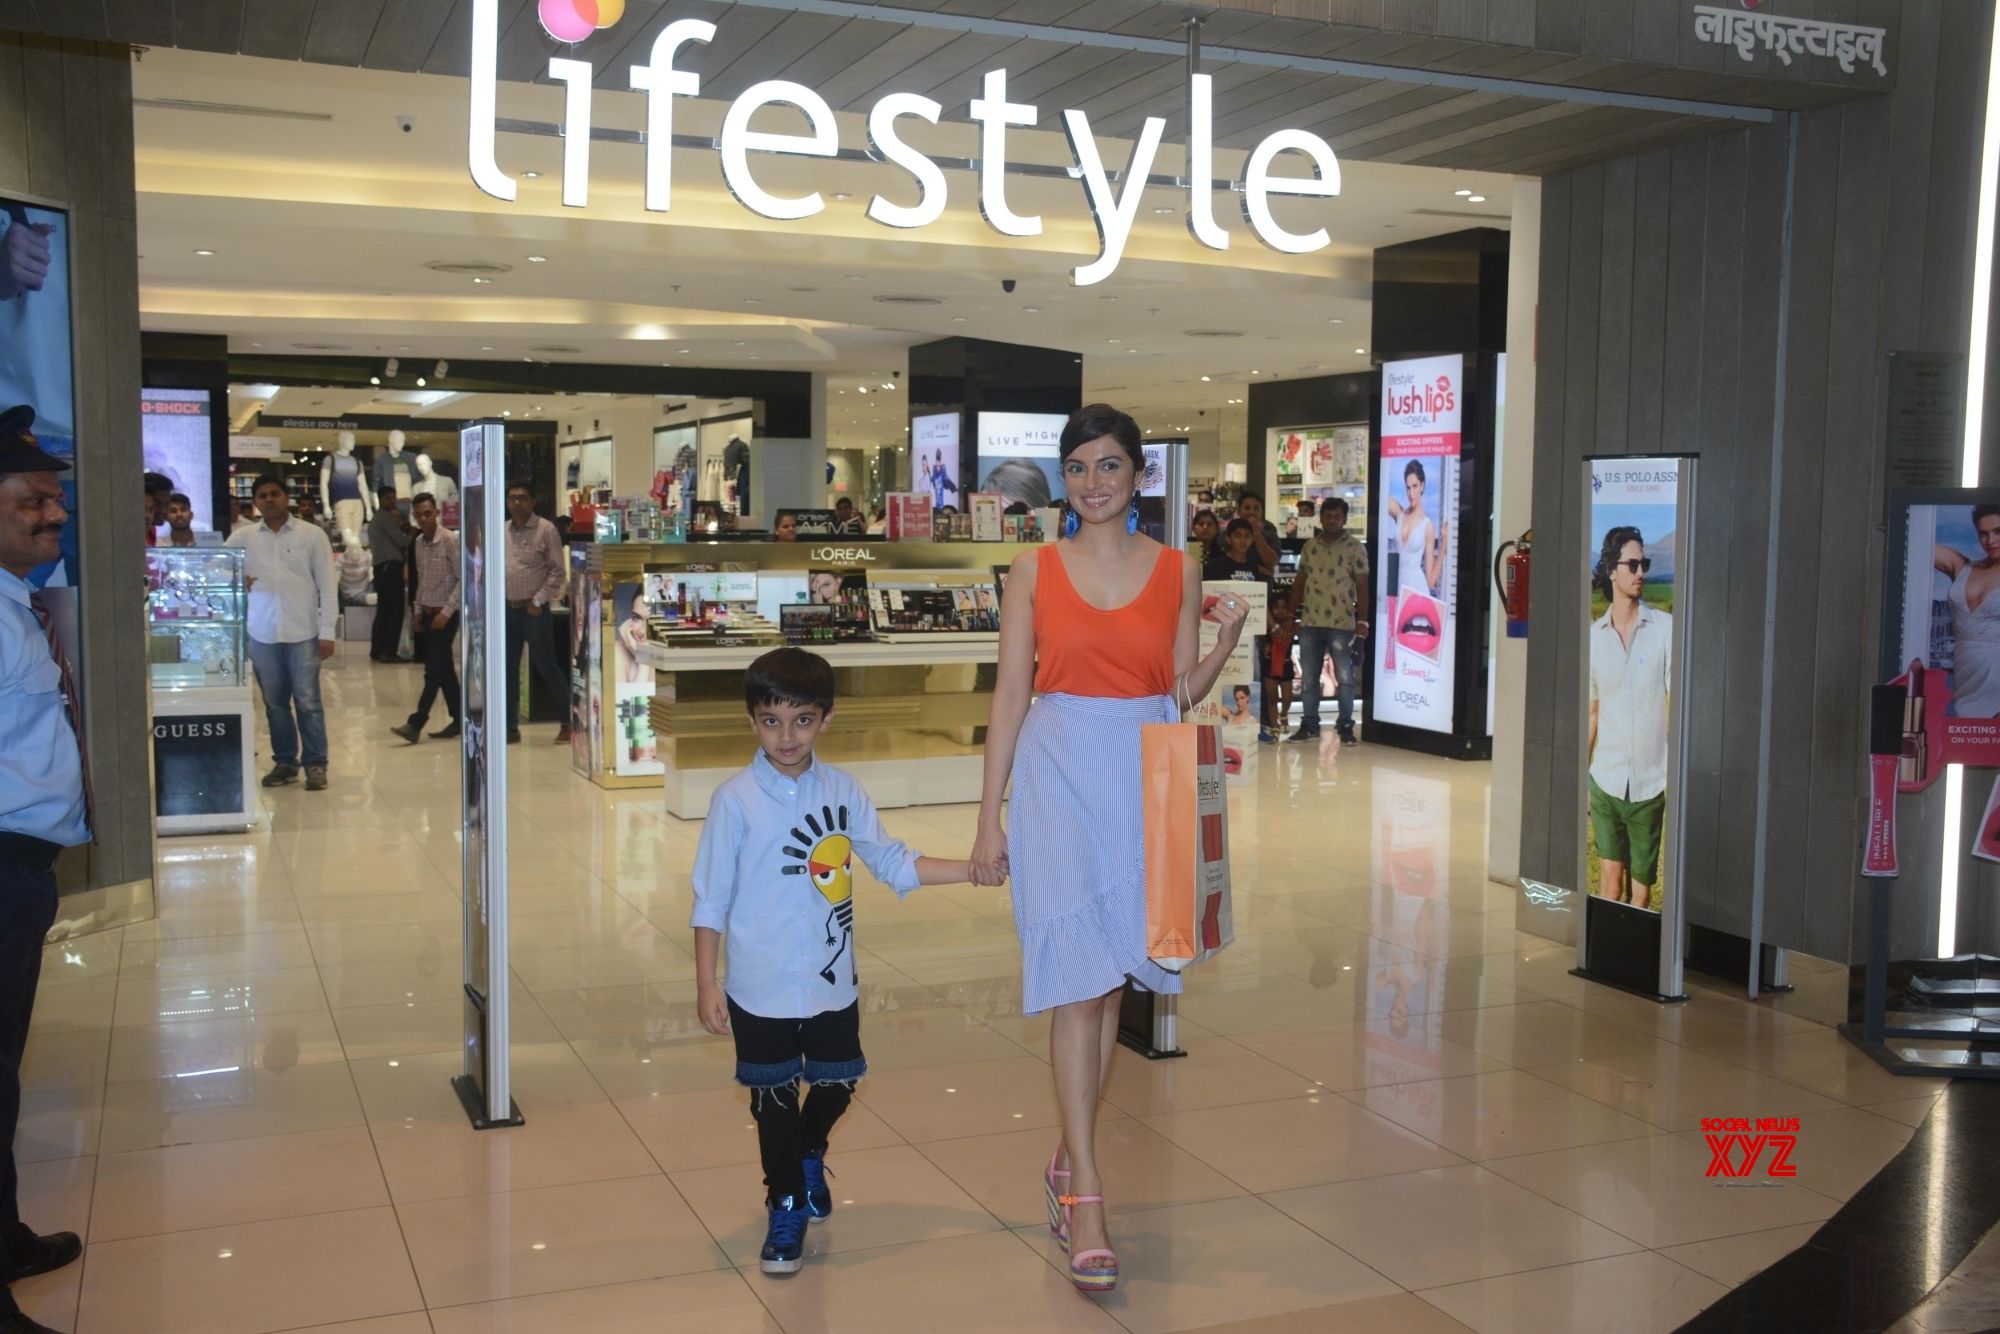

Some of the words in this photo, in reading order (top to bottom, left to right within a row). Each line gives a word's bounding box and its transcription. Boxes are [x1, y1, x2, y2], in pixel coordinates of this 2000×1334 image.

[467, 0, 1342, 287] lifestyle
[141, 402, 201, 414] G-SHOCK
[1387, 385, 1423, 416] lush
[1425, 384, 1454, 423] lips
[283, 419, 316, 428] please
[318, 419, 335, 430] pay
[336, 420, 359, 429] here
[1025, 430, 1058, 440] HIGH
[988, 436, 1020, 446] LIVE
[1396, 438, 1420, 446] EXCITING
[1422, 437, 1444, 445] OFFERS
[1624, 471, 1654, 483] POLO
[154, 722, 226, 738] GUESS
[1948, 725, 1996, 734] EXCITING
[1951, 736, 1965, 744] ON
[1967, 736, 1991, 744] YOUR
